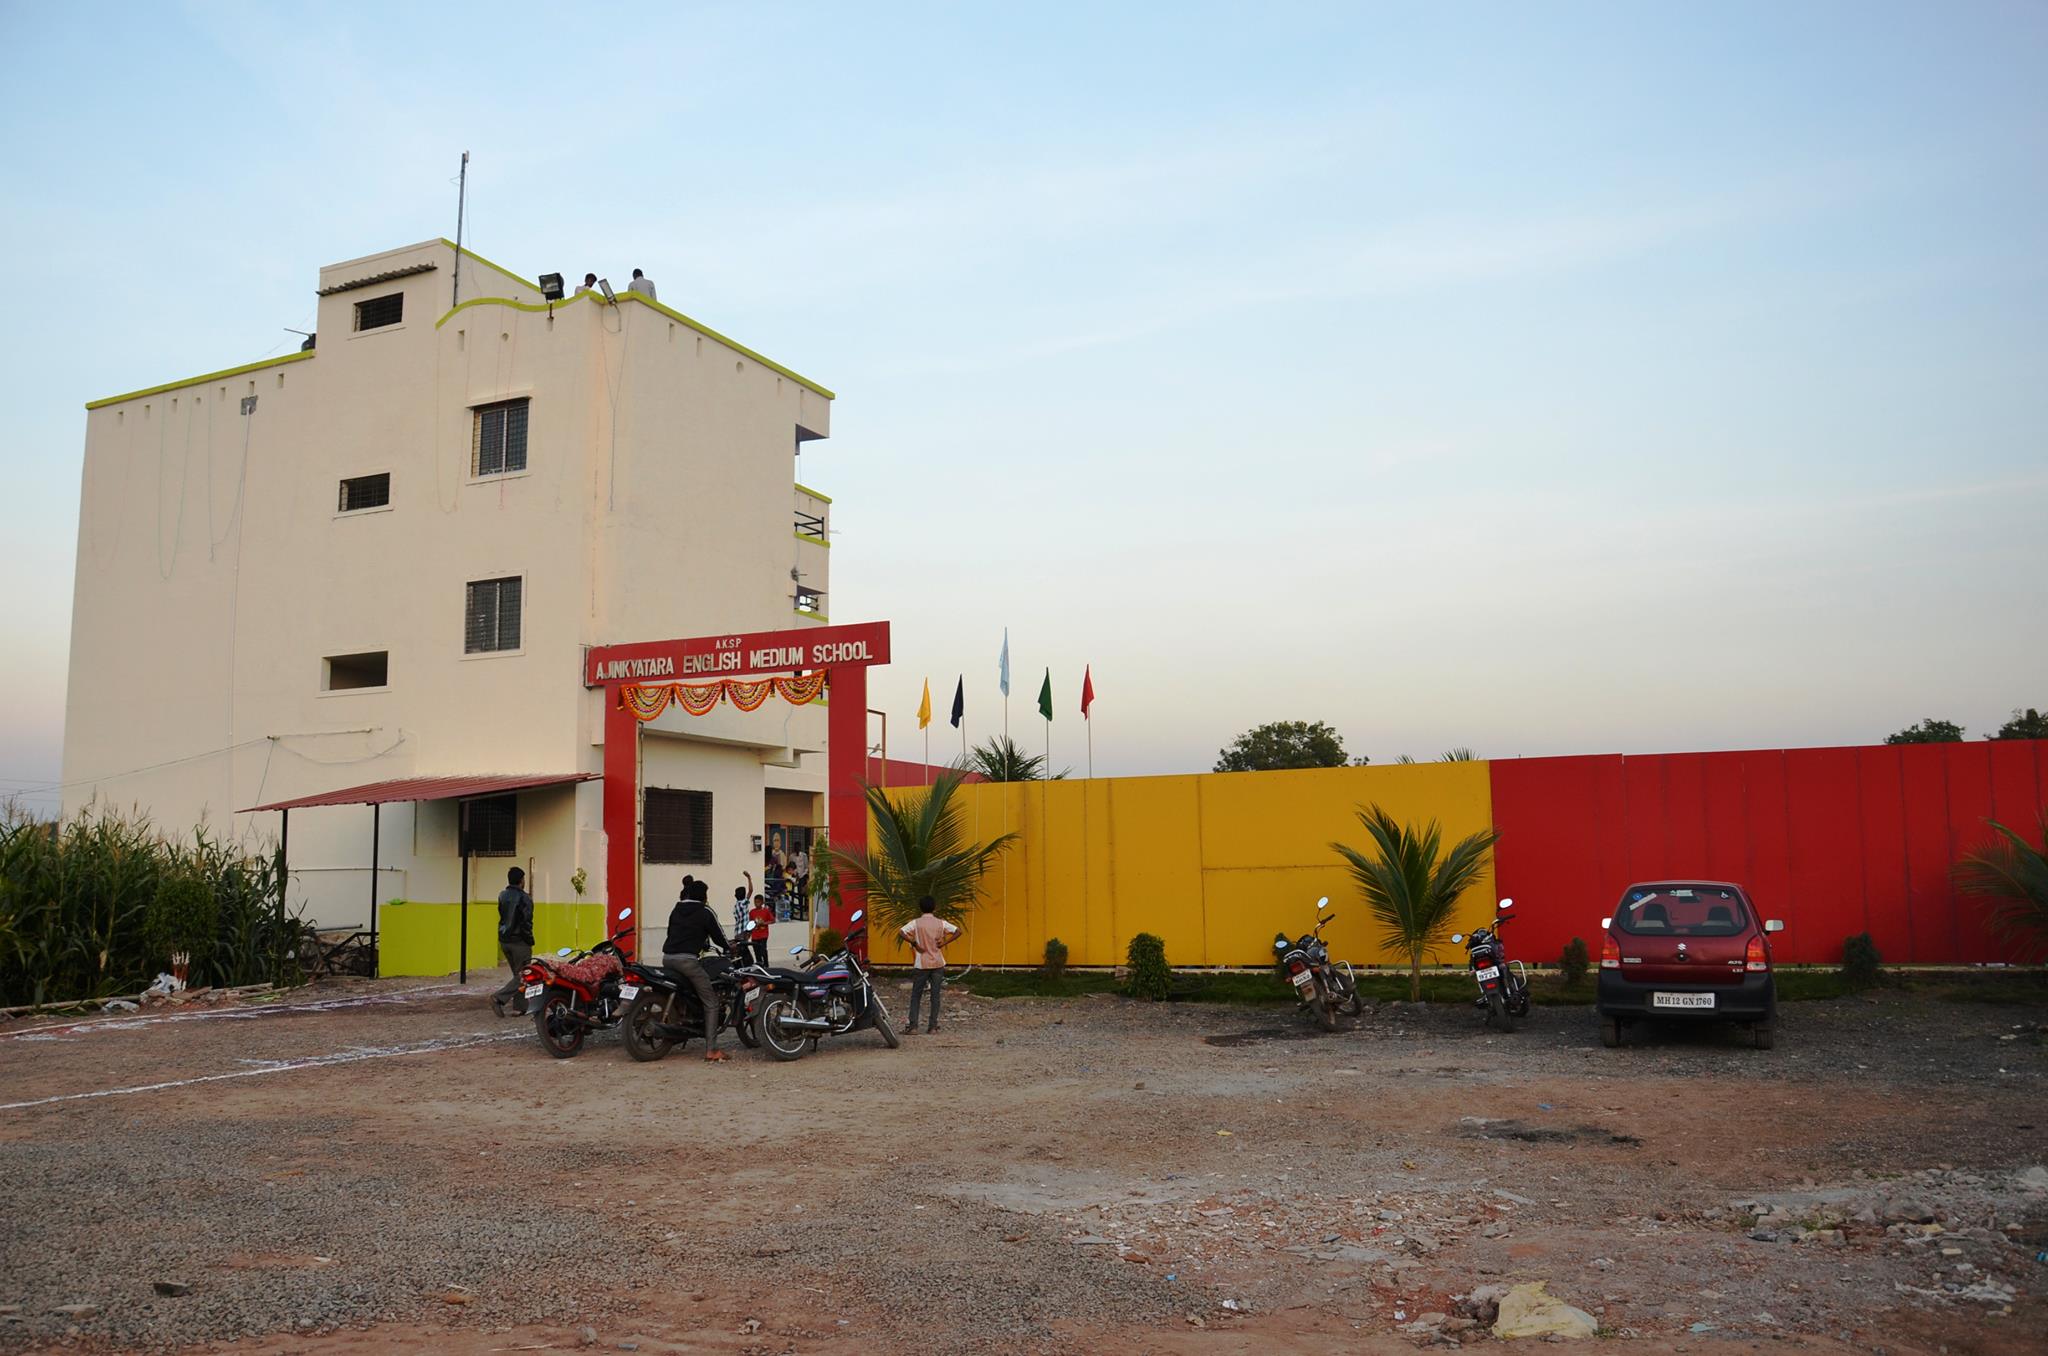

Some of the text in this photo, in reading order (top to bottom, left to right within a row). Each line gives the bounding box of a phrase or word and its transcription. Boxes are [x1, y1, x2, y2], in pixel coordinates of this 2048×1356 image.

[596, 640, 873, 680] AJINKYATARA ENGLISH MEDIUM SCHOOL
